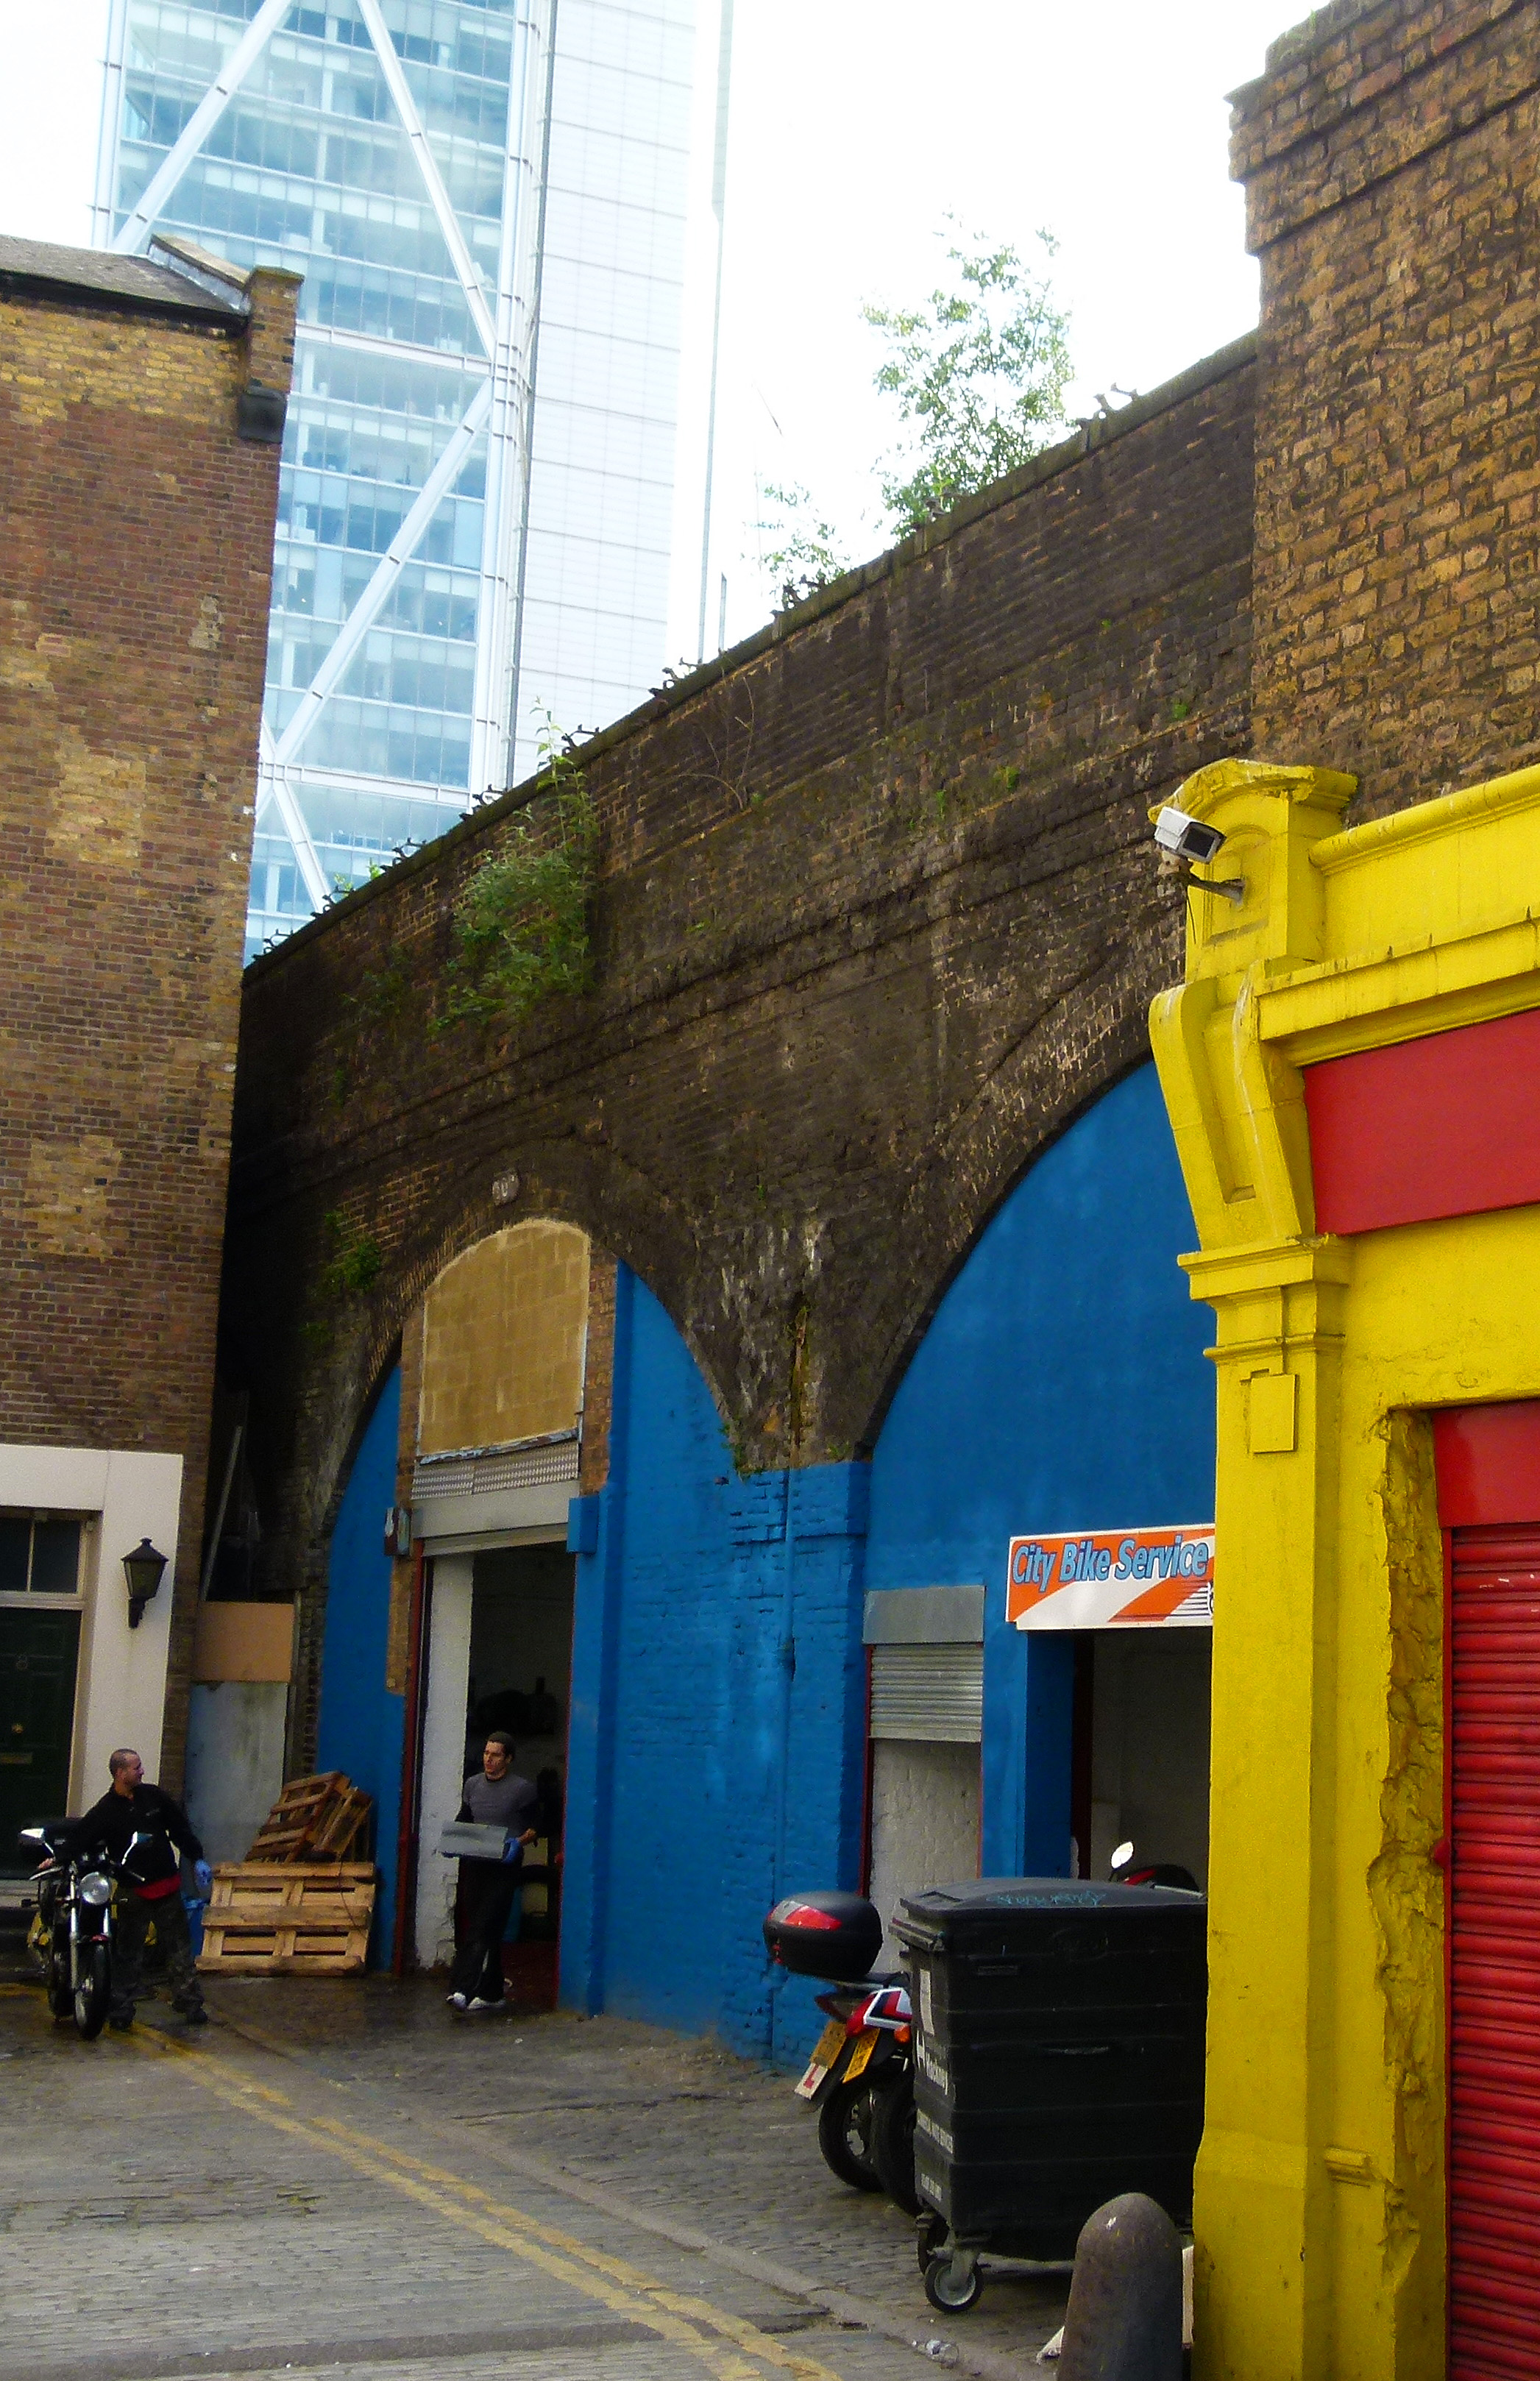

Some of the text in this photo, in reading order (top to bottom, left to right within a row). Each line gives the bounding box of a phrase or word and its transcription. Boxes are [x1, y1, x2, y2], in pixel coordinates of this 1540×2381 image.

[1012, 1534, 1209, 1593] City Bike Service
